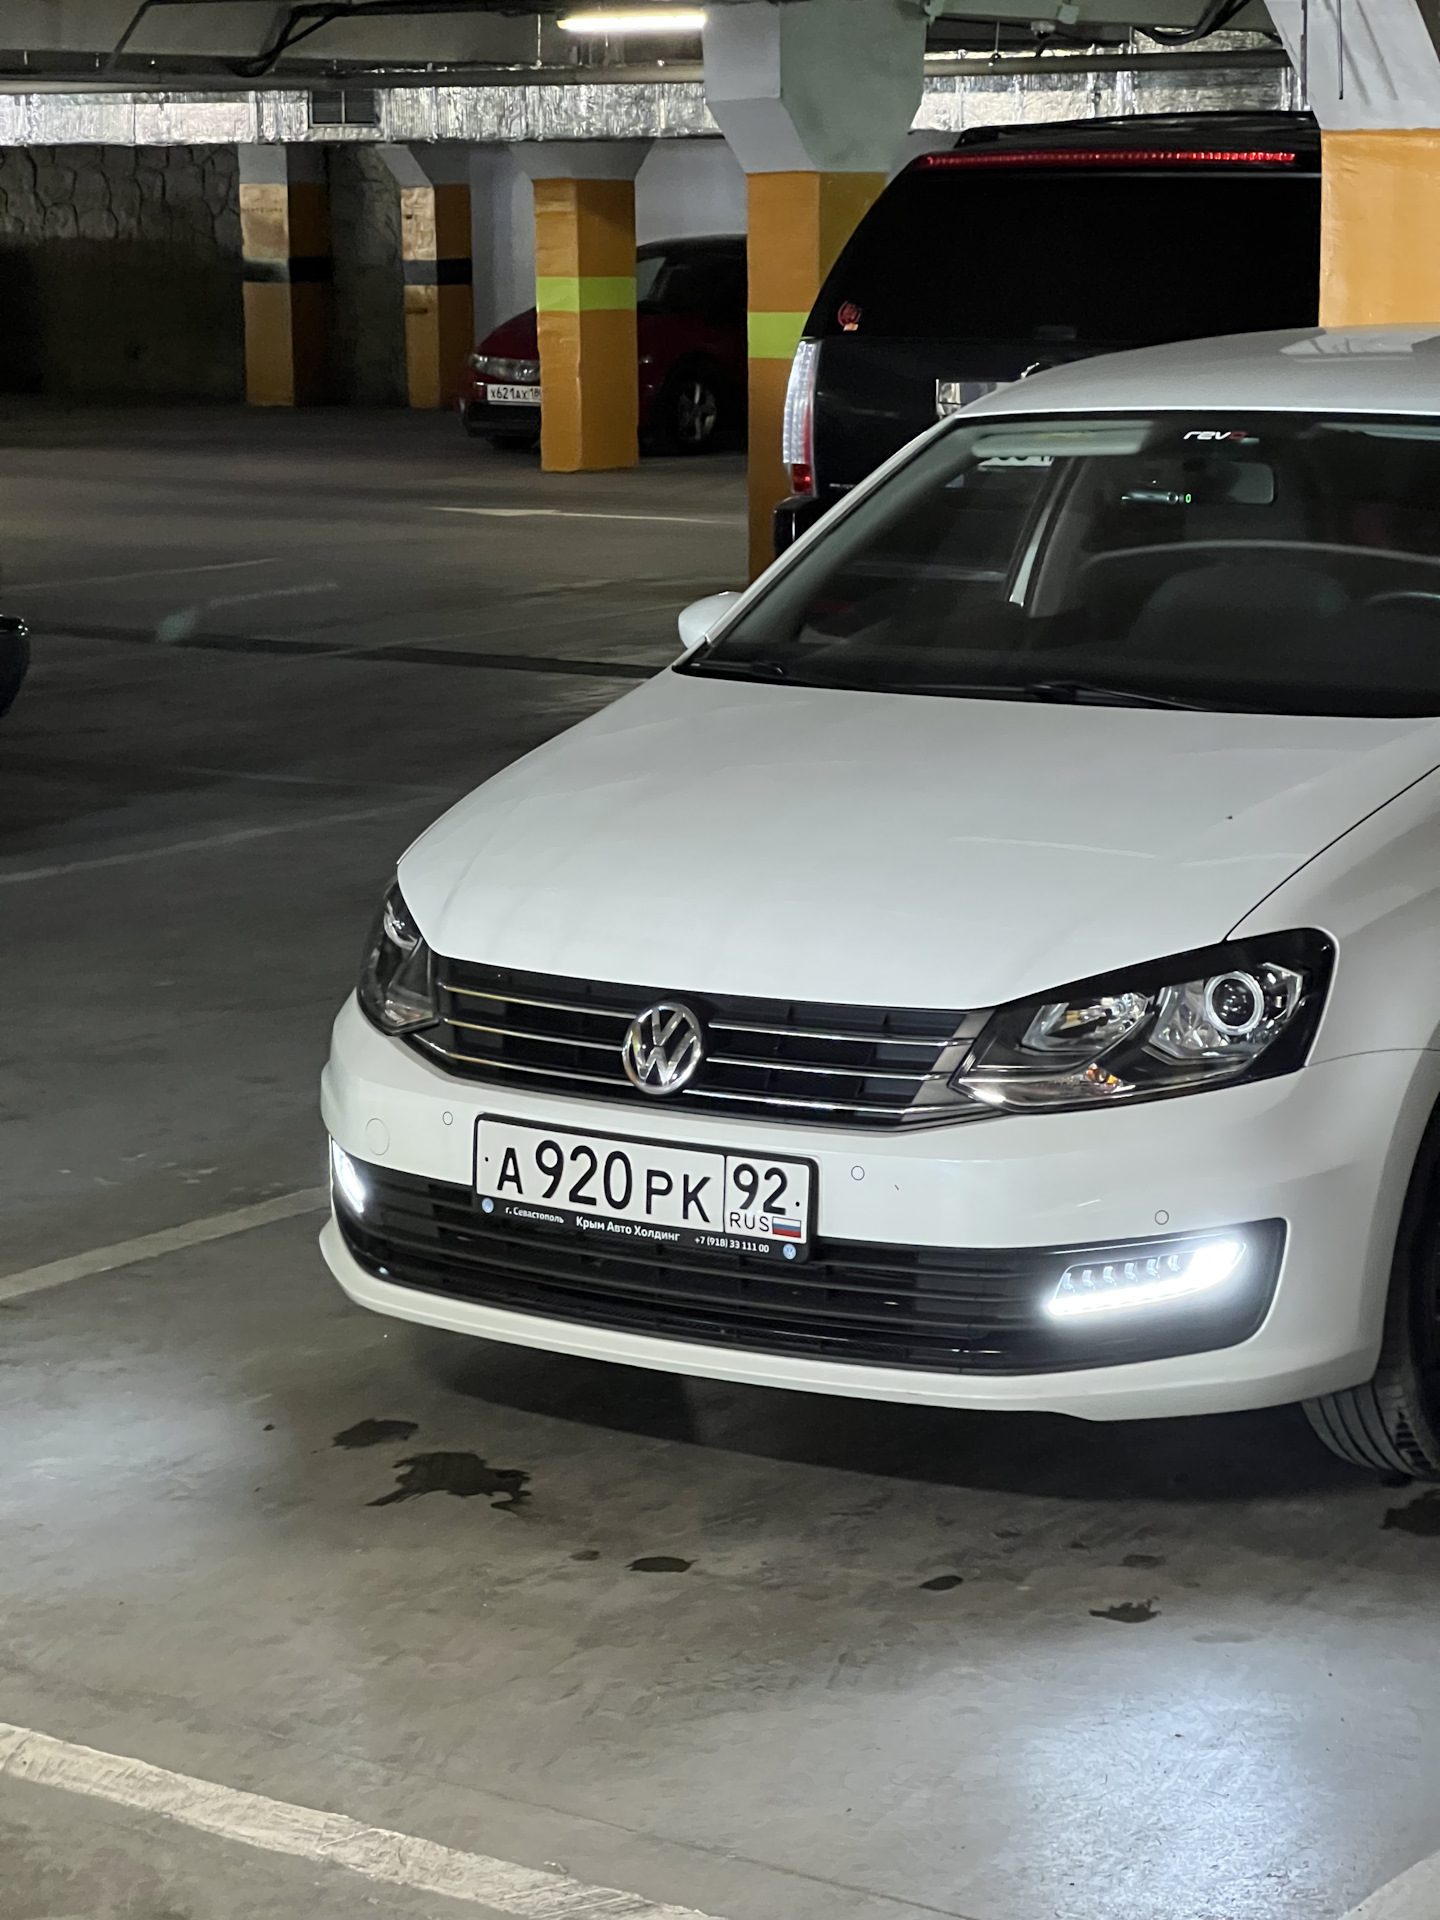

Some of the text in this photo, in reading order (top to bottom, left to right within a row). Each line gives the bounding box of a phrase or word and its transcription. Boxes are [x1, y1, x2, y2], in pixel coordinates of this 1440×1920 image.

[732, 1163, 788, 1216] 92
[513, 1206, 565, 1224] Севастополь
[729, 1212, 770, 1232] RUS
[576, 1216, 681, 1242] Крым Авто Холдинг
[694, 1236, 770, 1254] +7 (918) 33 111 00
